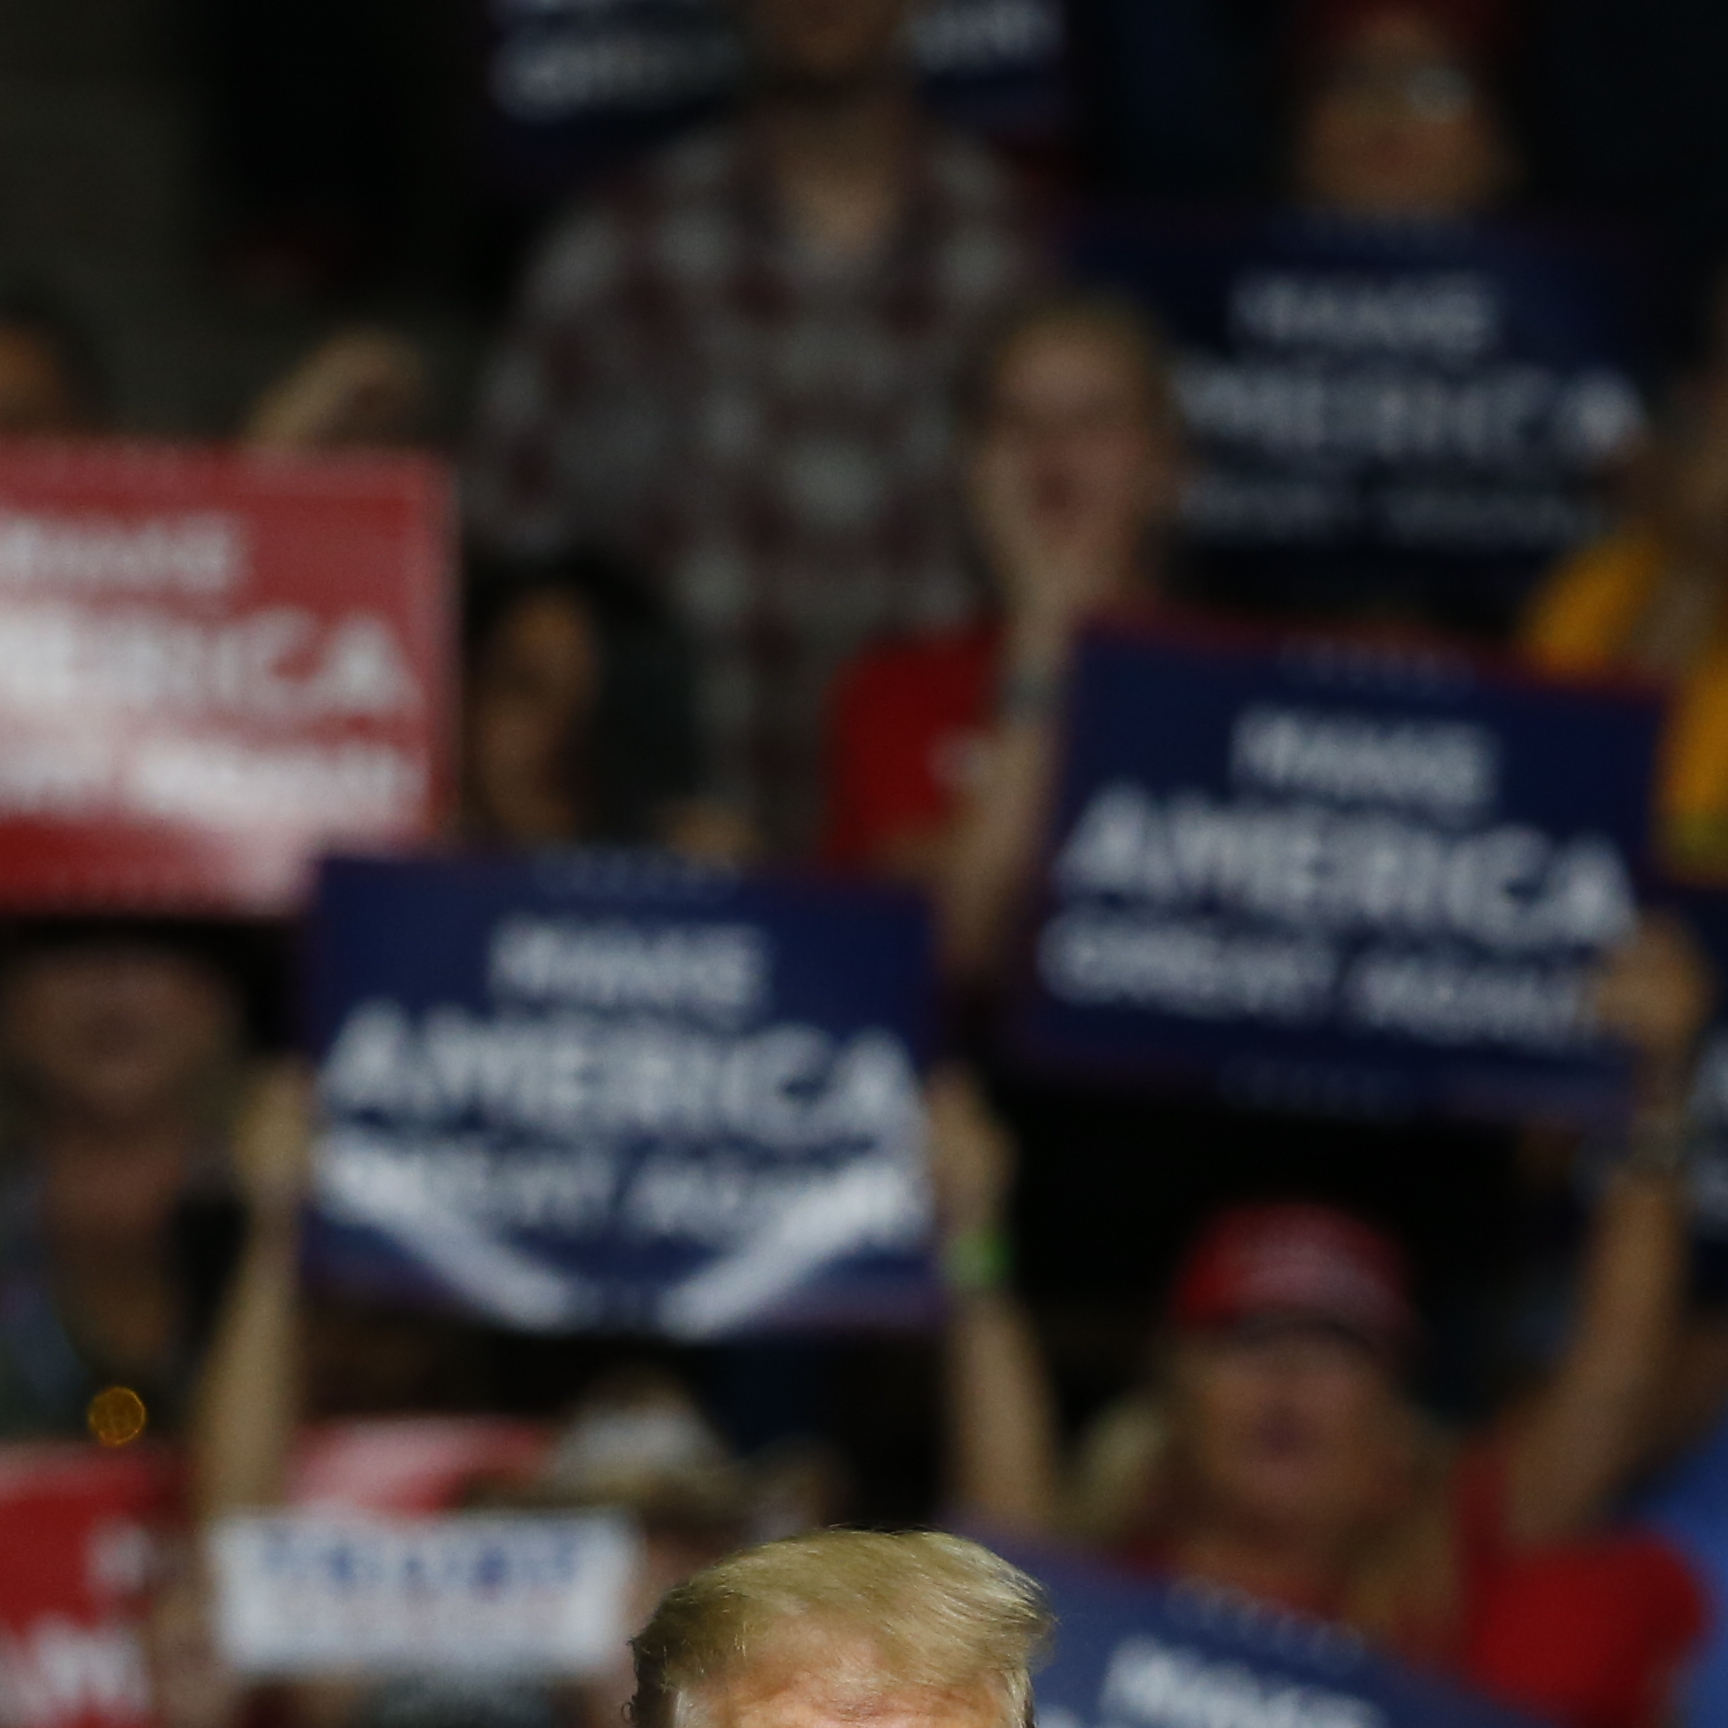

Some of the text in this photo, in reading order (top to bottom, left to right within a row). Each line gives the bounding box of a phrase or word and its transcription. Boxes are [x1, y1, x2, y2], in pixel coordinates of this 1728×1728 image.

[1167, 359, 1650, 462] MERICA
[1231, 698, 1503, 808] MAKE
[1050, 785, 1638, 950] AMERICA
[485, 920, 776, 1012] MAKE
[320, 1000, 934, 1148] AMERICA
